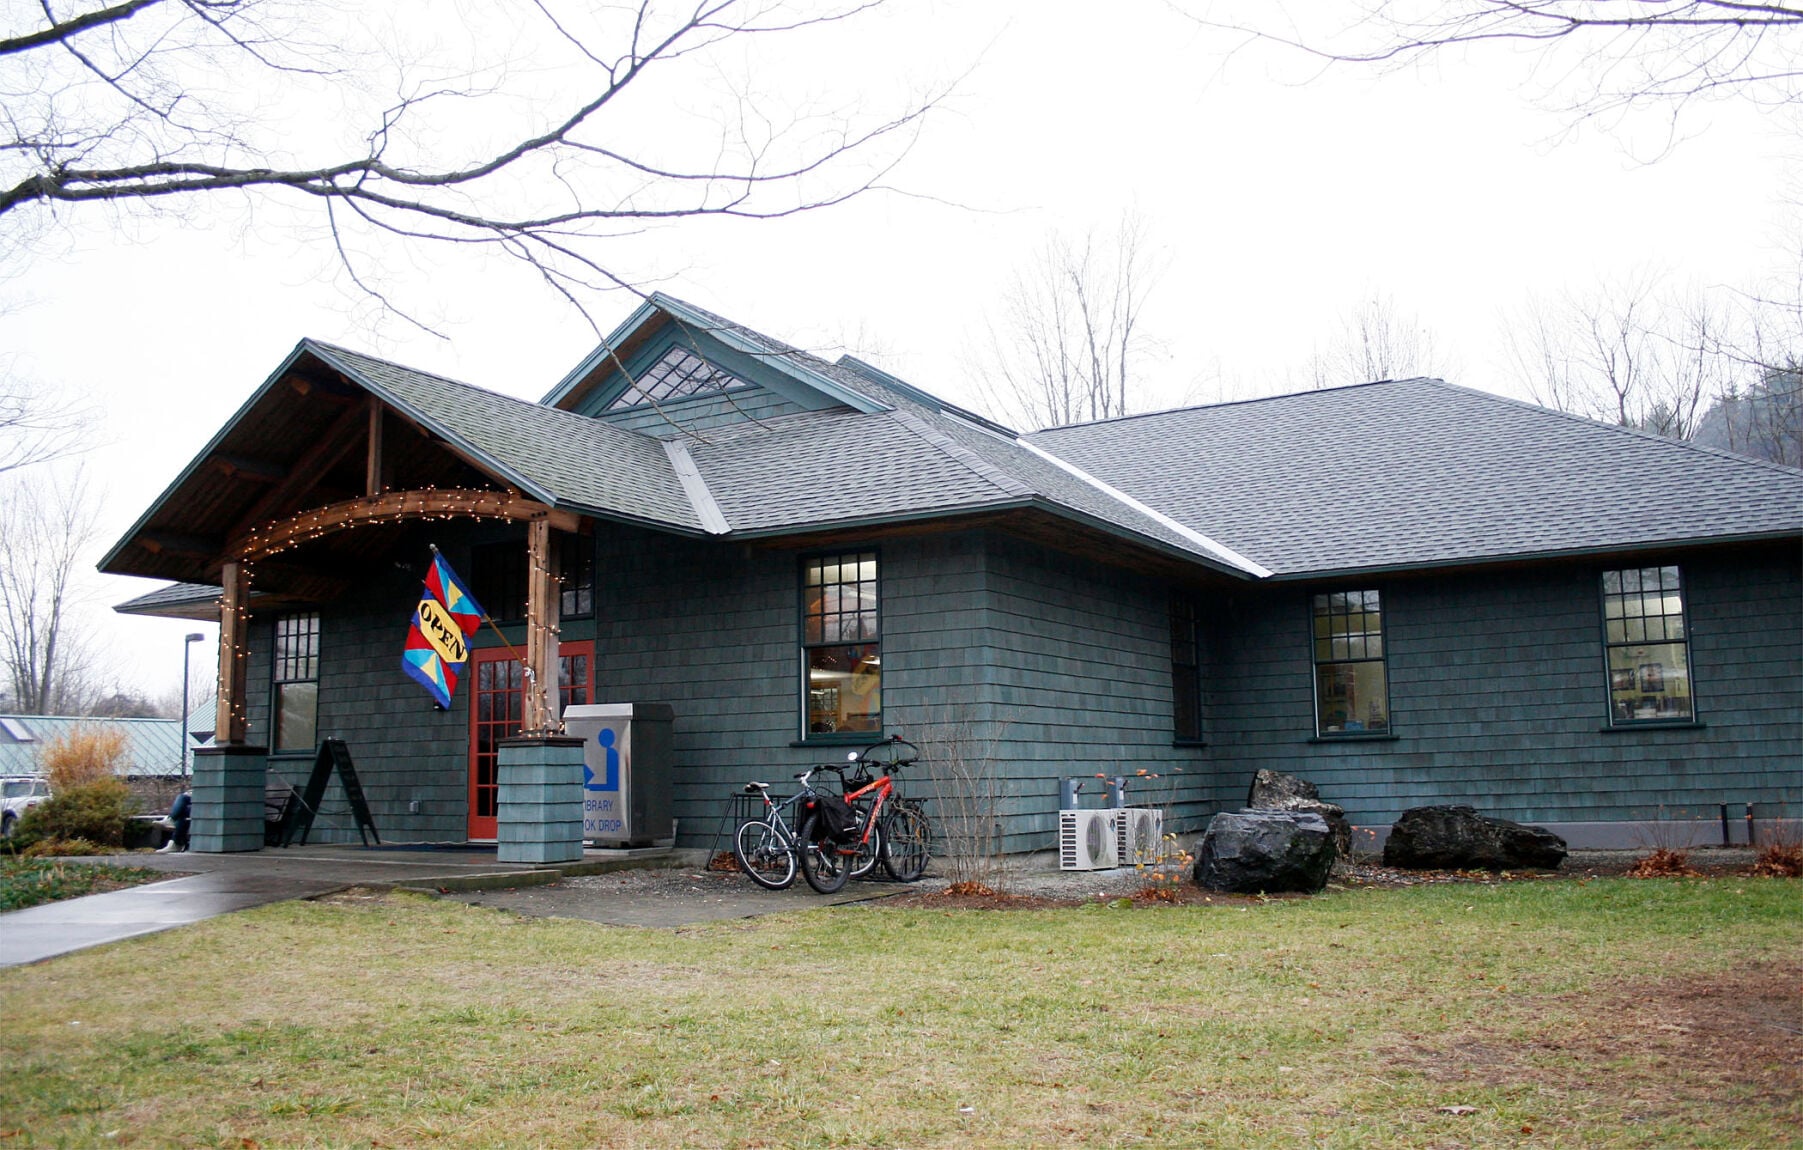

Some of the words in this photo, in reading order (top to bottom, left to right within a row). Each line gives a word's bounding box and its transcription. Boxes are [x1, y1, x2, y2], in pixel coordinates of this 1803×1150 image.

[420, 602, 465, 660] OPEN
[584, 799, 614, 812] IBRARY
[584, 818, 596, 831] OK
[598, 819, 622, 831] DROP
